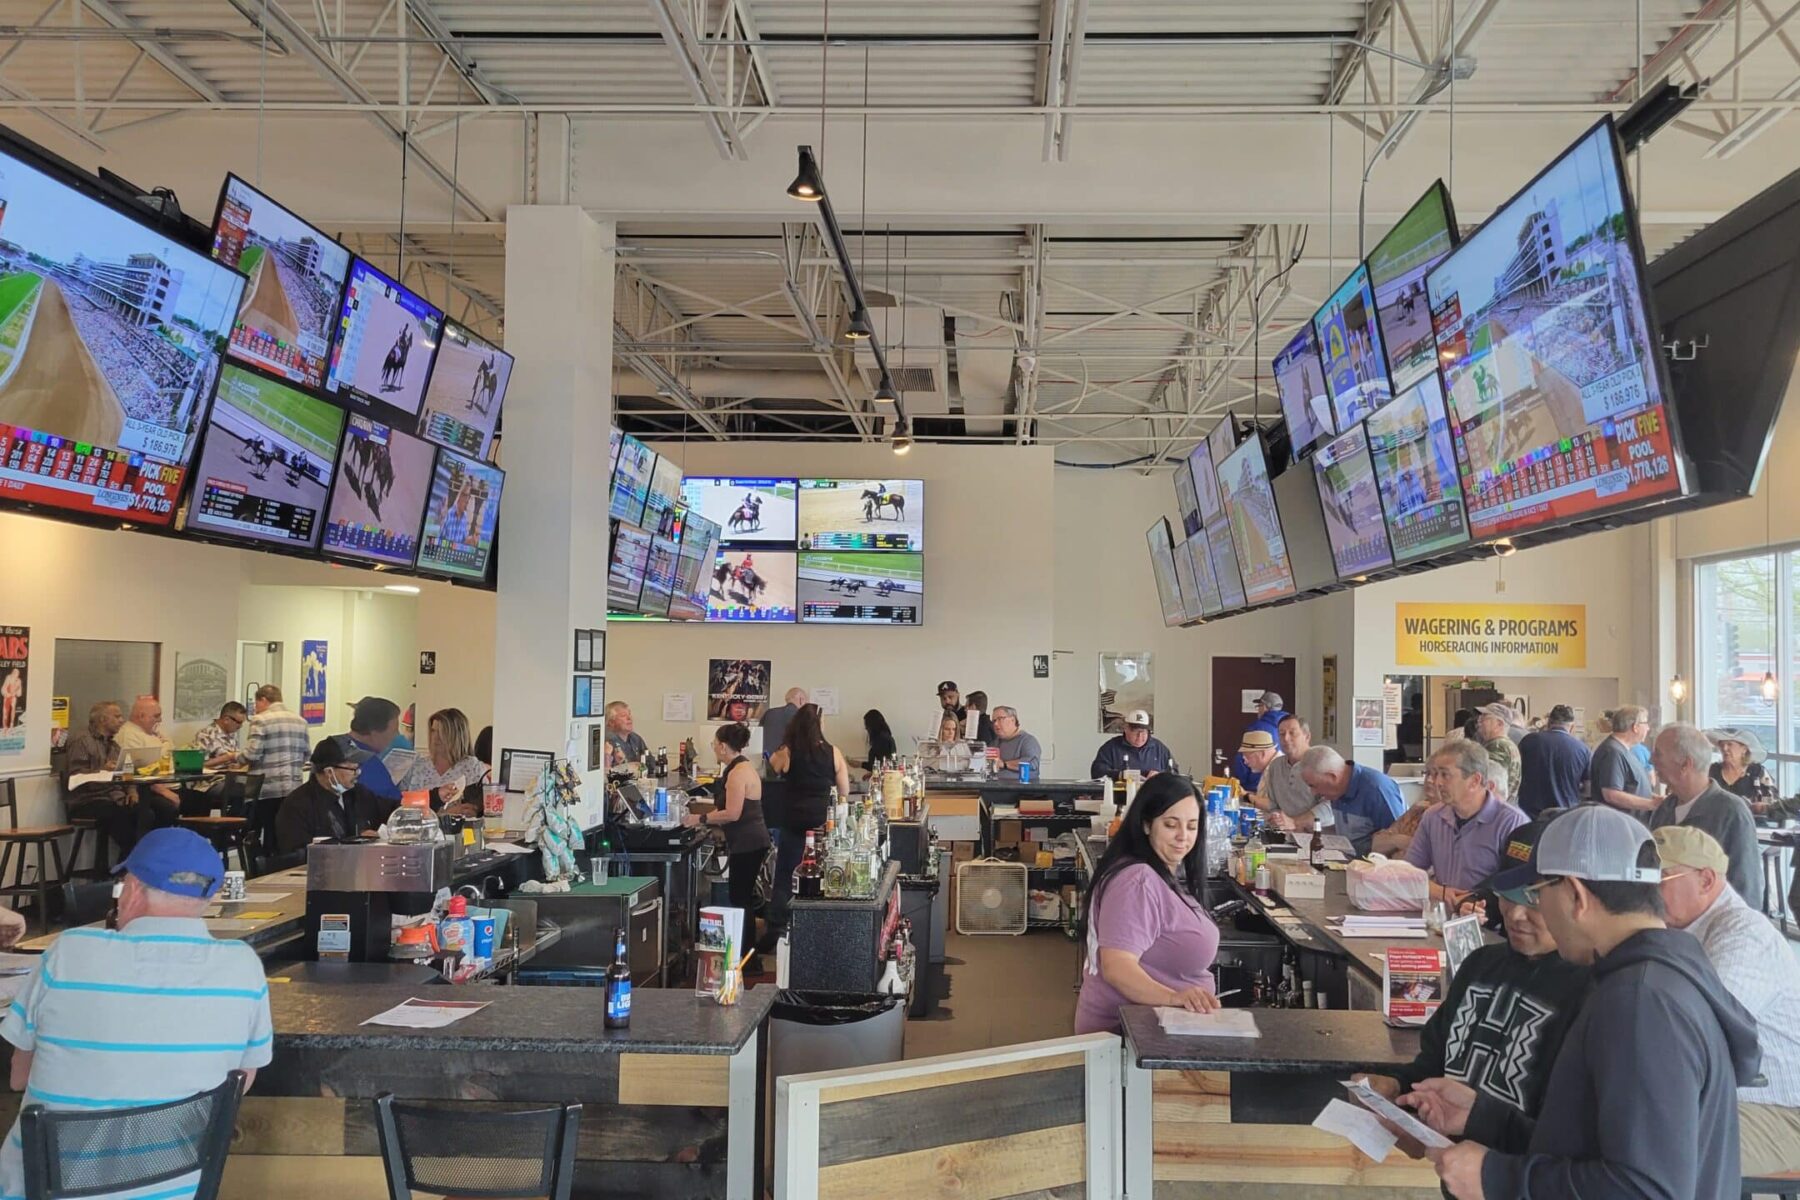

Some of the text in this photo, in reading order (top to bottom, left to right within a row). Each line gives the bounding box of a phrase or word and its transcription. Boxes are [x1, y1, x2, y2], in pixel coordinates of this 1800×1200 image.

[157, 429, 168, 439] OLD
[1615, 411, 1660, 444] PICK FIVE
[17, 440, 24, 450] 7
[47, 448, 56, 458] 14
[1628, 440, 1655, 460] POOL
[139, 461, 180, 484] PICK FIVE
[143, 482, 166, 496] POOL
[129, 494, 172, 512] $1,778,126
[1405, 618, 1578, 637] WAGERING & PROGRAMS
[1419, 640, 1559, 655] HORSERACING INFORMATION
